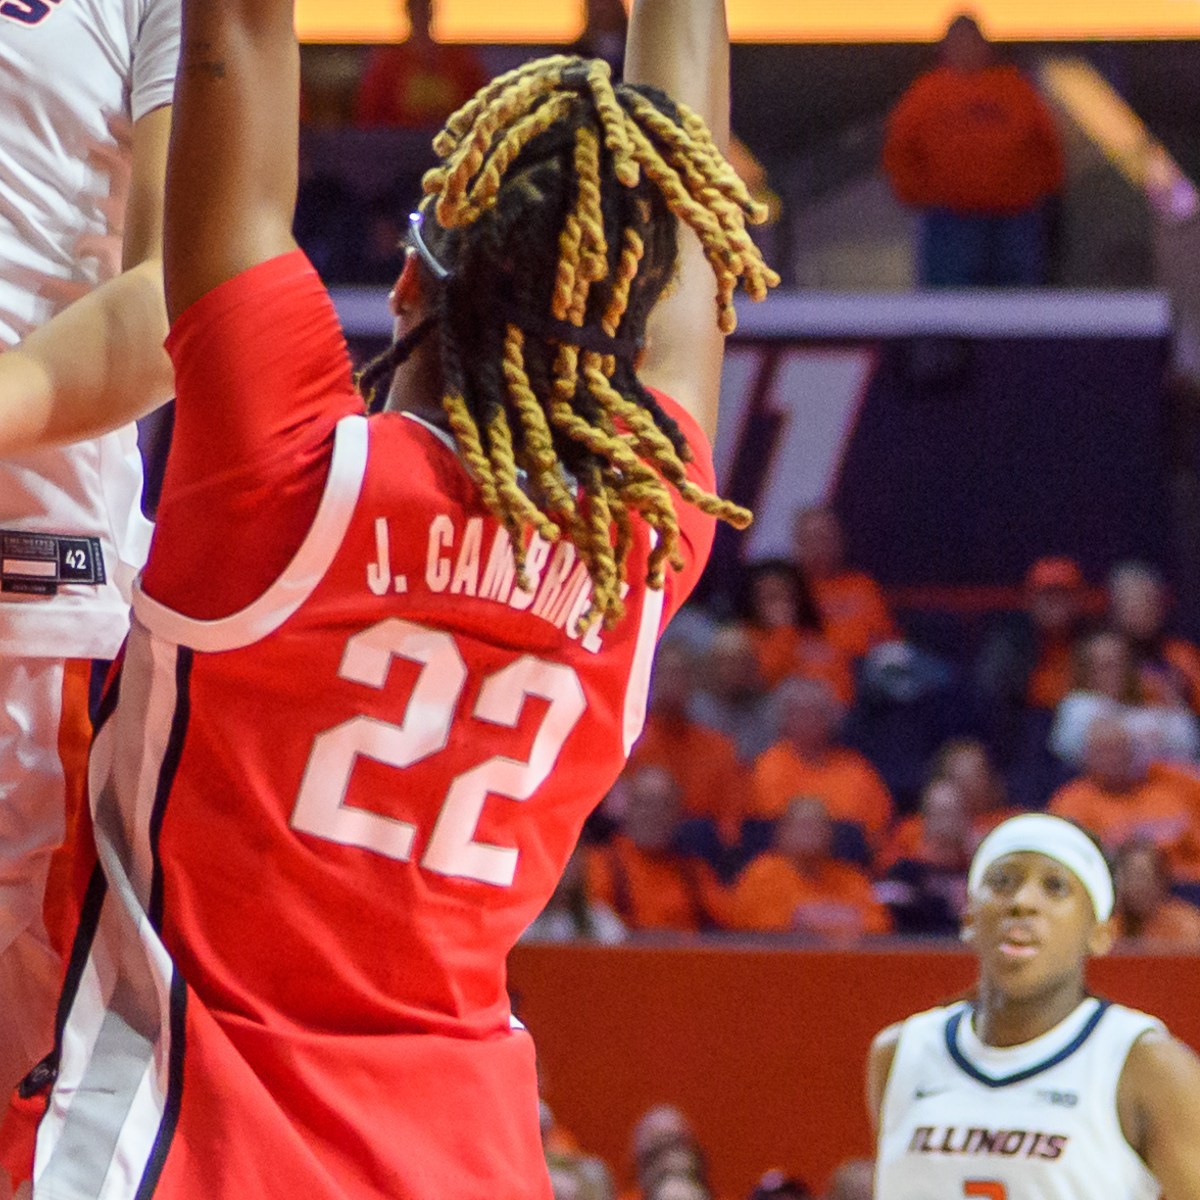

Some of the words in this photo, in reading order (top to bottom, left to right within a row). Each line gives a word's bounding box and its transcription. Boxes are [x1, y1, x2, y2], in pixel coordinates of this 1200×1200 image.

[65, 549, 87, 570] 42
[367, 516, 407, 595] J.
[290, 616, 588, 888] 22
[907, 1126, 1068, 1160] ILLINOIS
